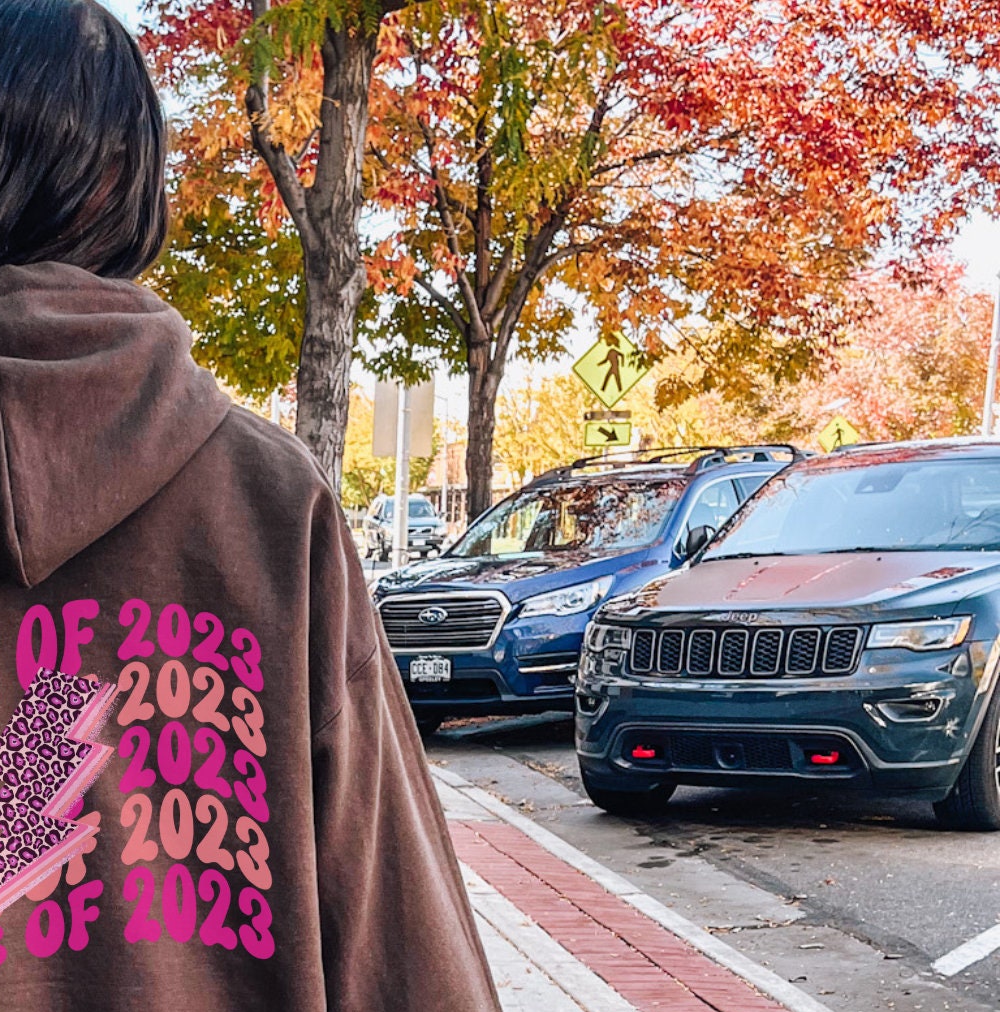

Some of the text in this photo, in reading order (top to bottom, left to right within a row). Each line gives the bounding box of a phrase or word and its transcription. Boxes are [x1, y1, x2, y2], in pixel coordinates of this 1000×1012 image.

[16, 599, 100, 692] OF
[117, 599, 265, 692] 2023
[720, 611, 758, 622] Jeep
[117, 660, 267, 757] 2023
[118, 721, 270, 823] 2023
[120, 789, 272, 890] 2023
[25, 879, 104, 958] OF
[123, 863, 275, 960] 2023
